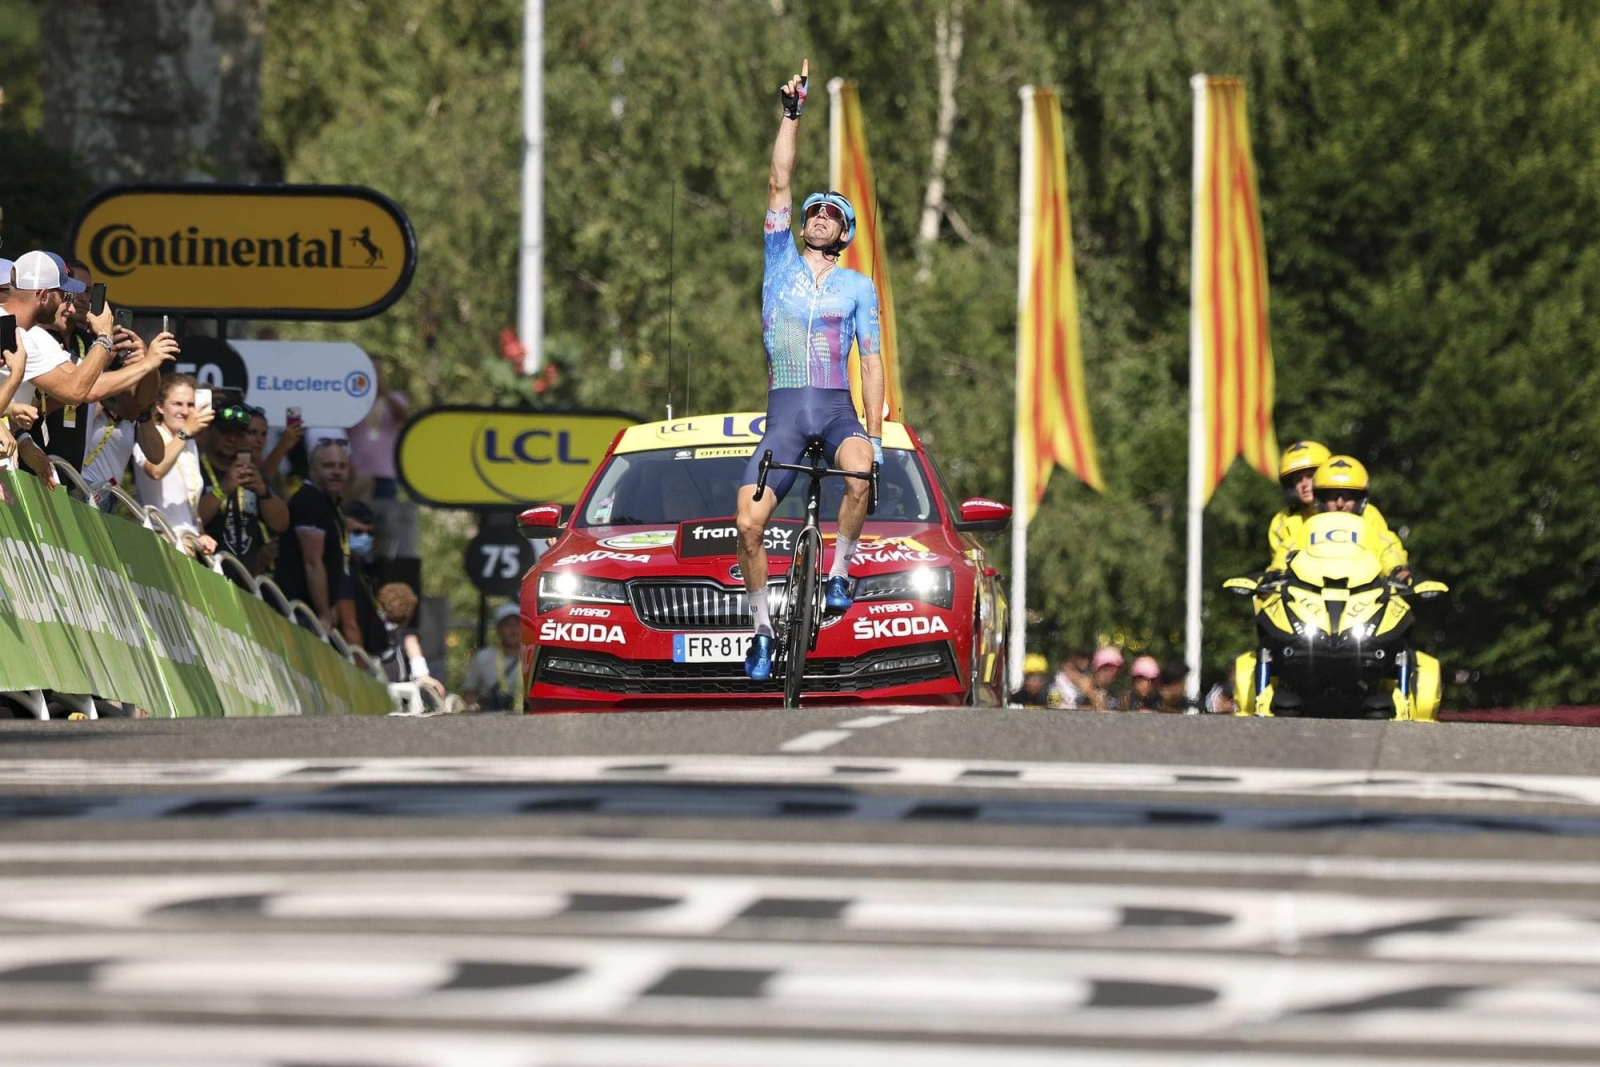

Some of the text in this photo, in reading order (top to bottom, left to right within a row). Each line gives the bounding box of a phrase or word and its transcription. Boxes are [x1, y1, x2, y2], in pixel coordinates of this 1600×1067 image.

[90, 224, 345, 277] Continental
[256, 375, 342, 392] E.Leclerc
[661, 423, 698, 434] LCL
[485, 429, 589, 464] LCL
[480, 544, 520, 578] 75
[569, 607, 611, 618] HYBRID
[868, 603, 914, 614] HYBRID
[539, 619, 626, 644] ŠKODA
[853, 616, 949, 640] ŠKODA
